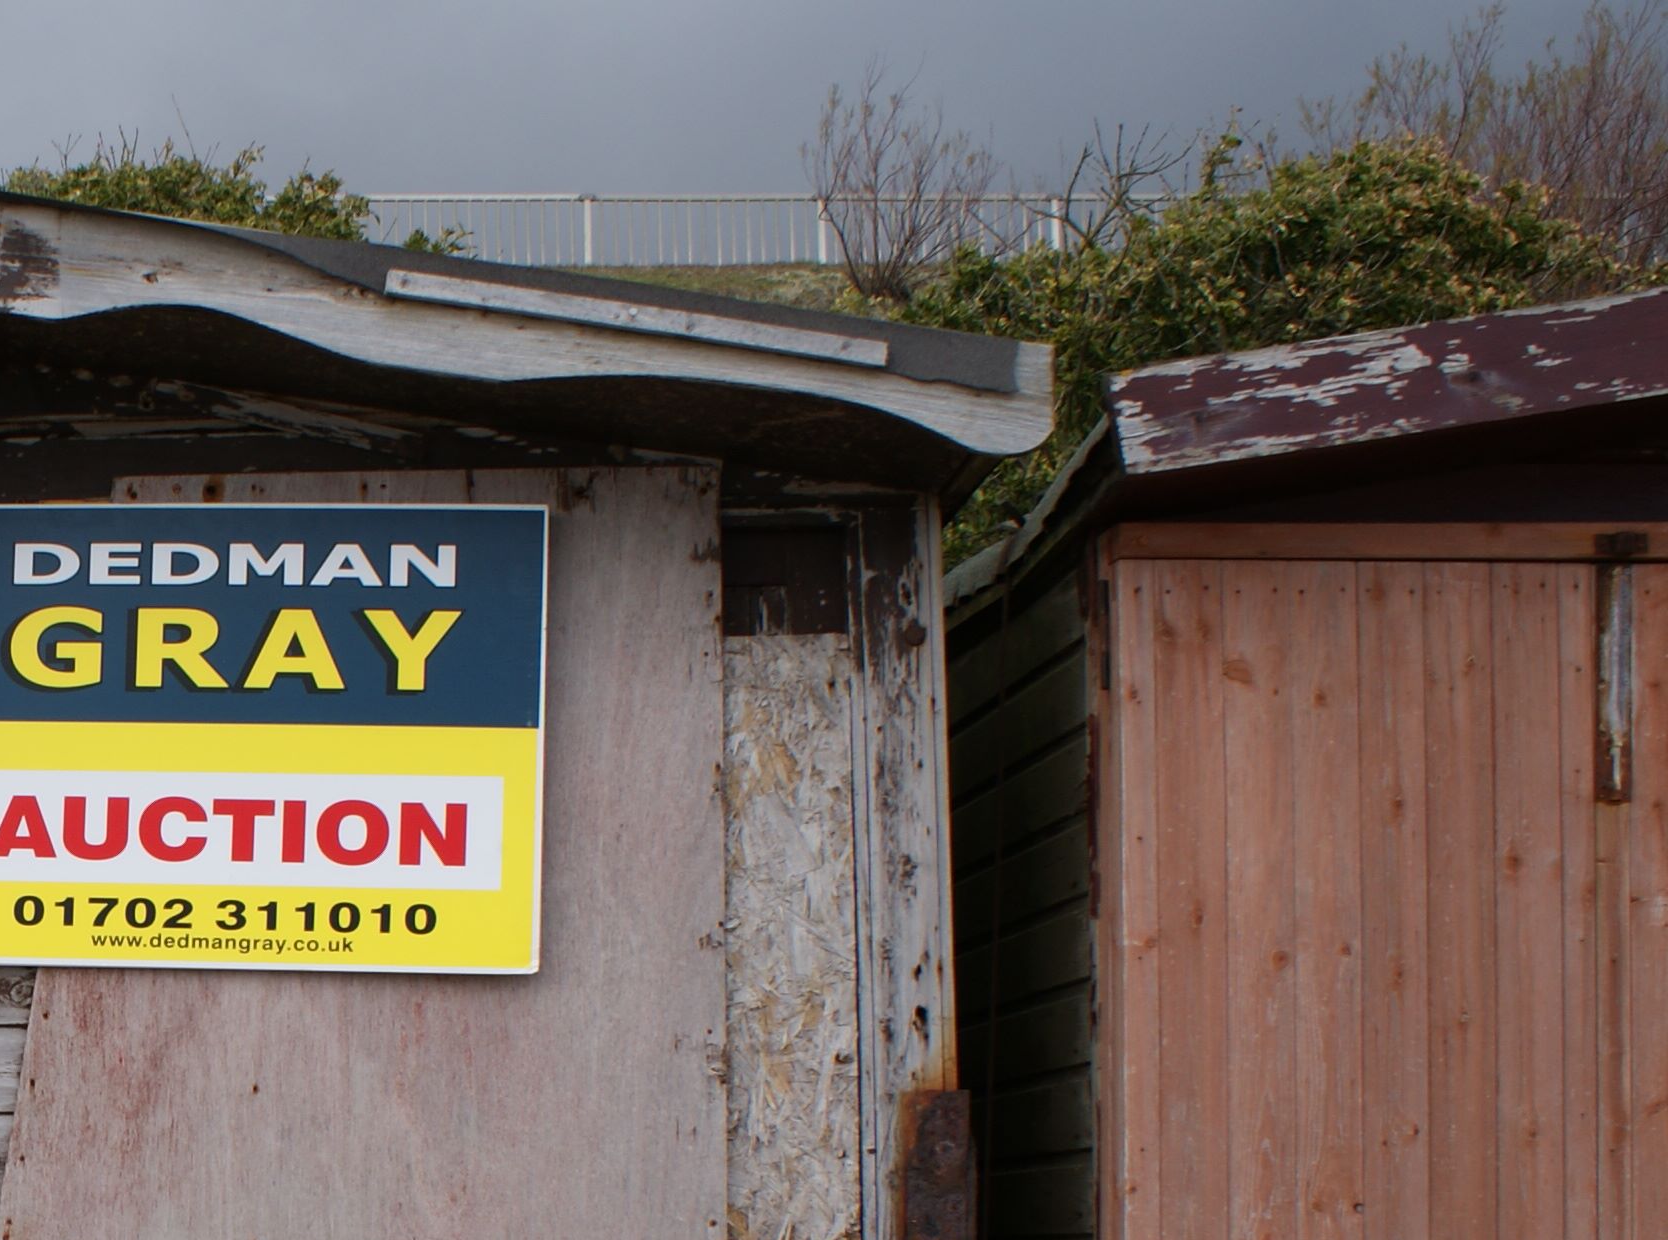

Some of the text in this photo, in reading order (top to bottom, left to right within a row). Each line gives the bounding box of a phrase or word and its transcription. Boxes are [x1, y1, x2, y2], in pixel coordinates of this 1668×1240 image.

[12, 542, 457, 588] DEDMAN
[7, 605, 464, 693] GRAY
[13, 895, 438, 935] 01702 311010
[91, 932, 354, 954] www.dedmangray.co.uk
